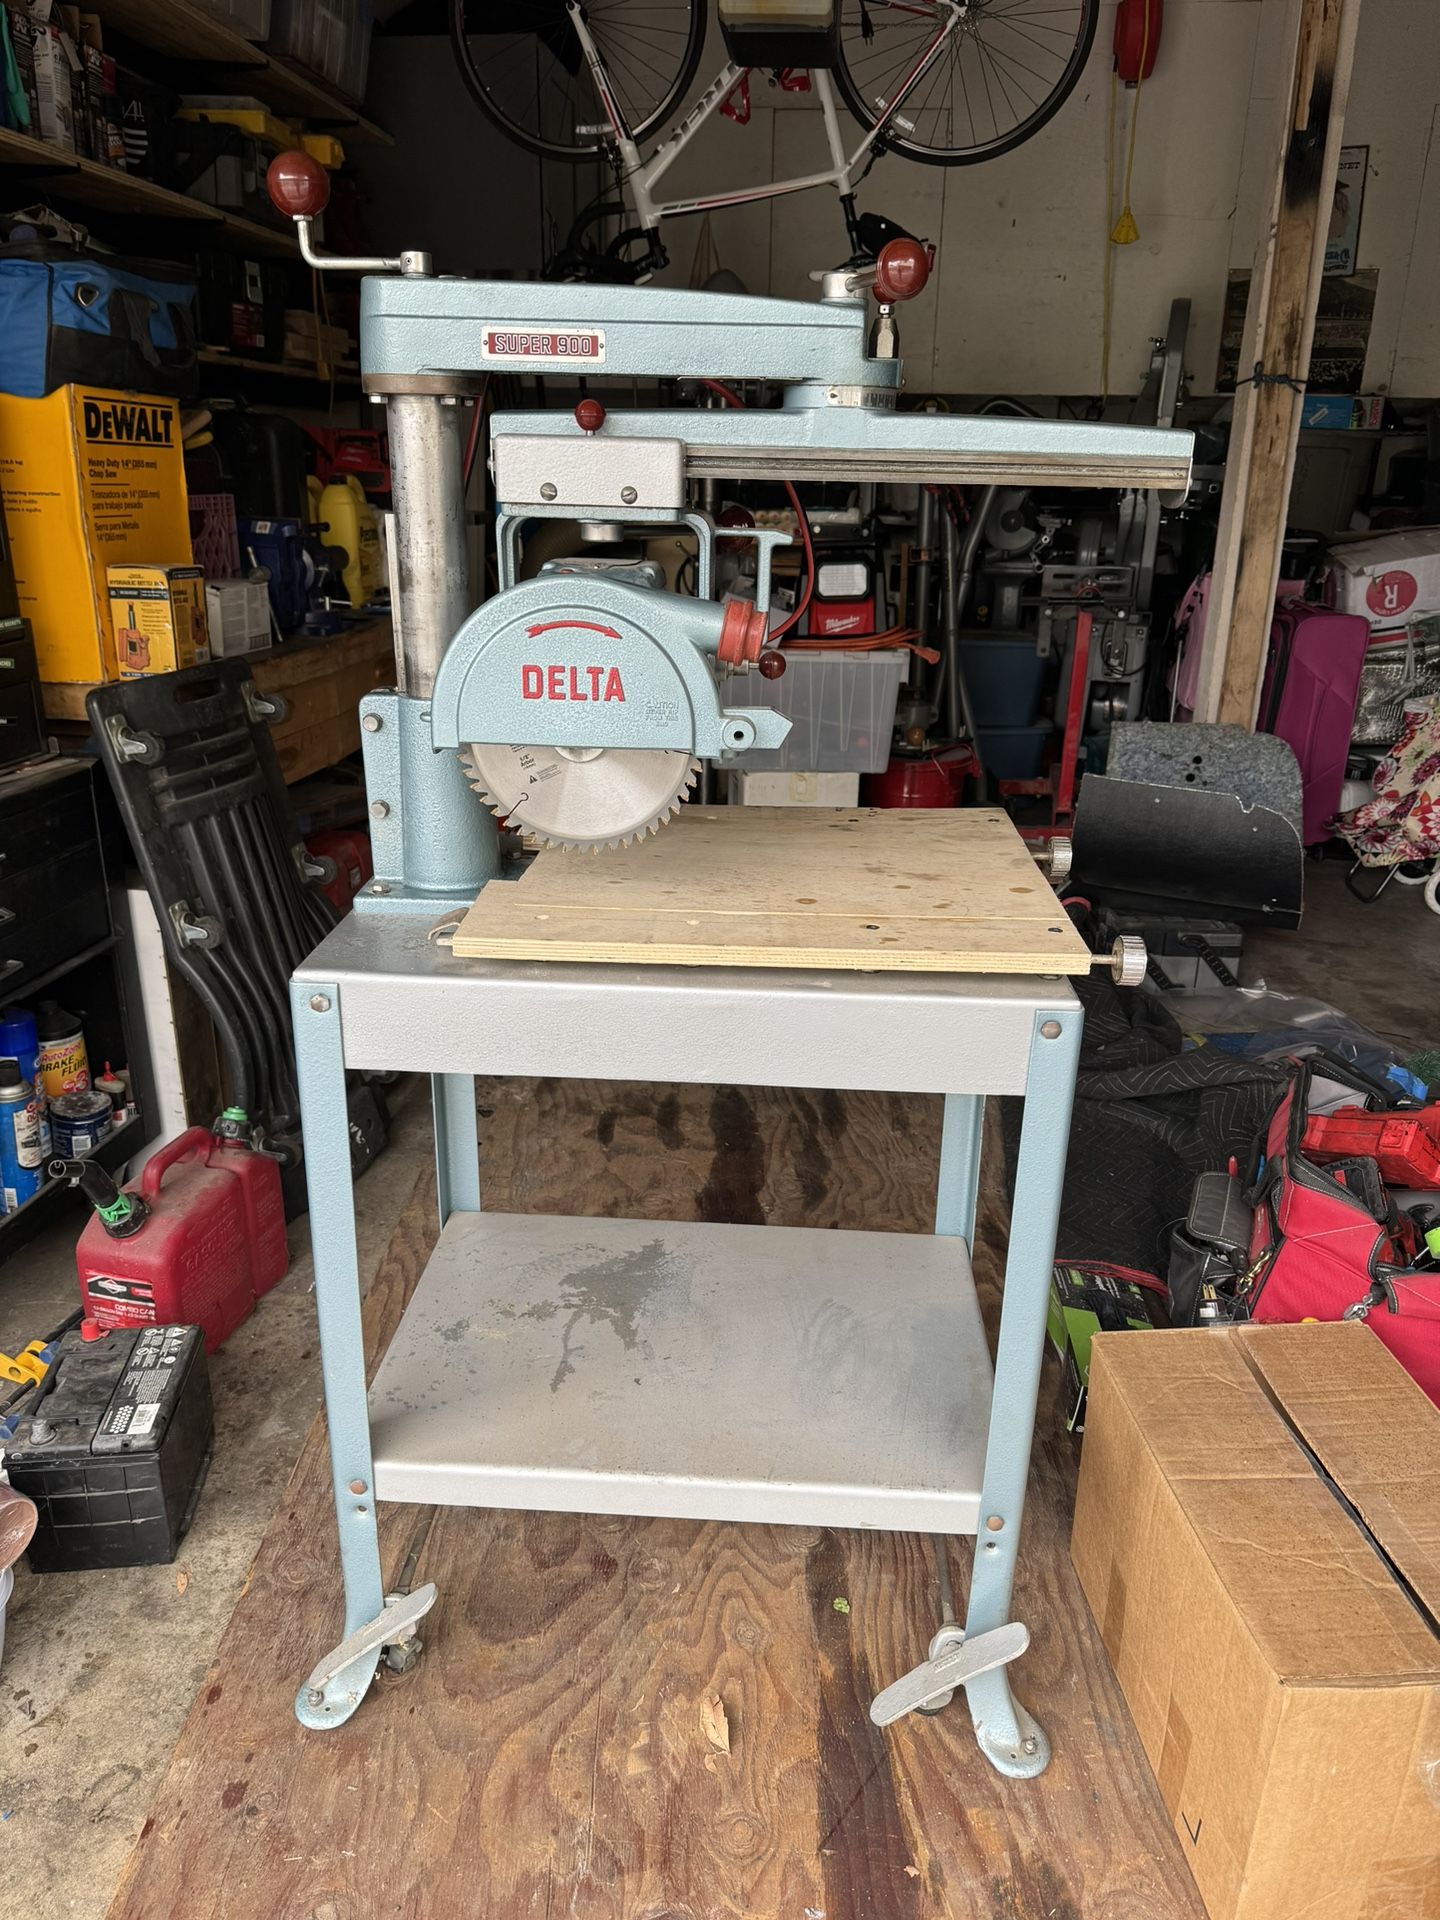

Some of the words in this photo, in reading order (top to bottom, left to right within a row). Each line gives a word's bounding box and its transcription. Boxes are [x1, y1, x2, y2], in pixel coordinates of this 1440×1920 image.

[668, 62, 738, 147] TREK
[495, 334, 552, 354] SUPER
[557, 336, 592, 356] 900
[83, 401, 173, 443] DEWALT
[522, 664, 626, 702] DELTA
